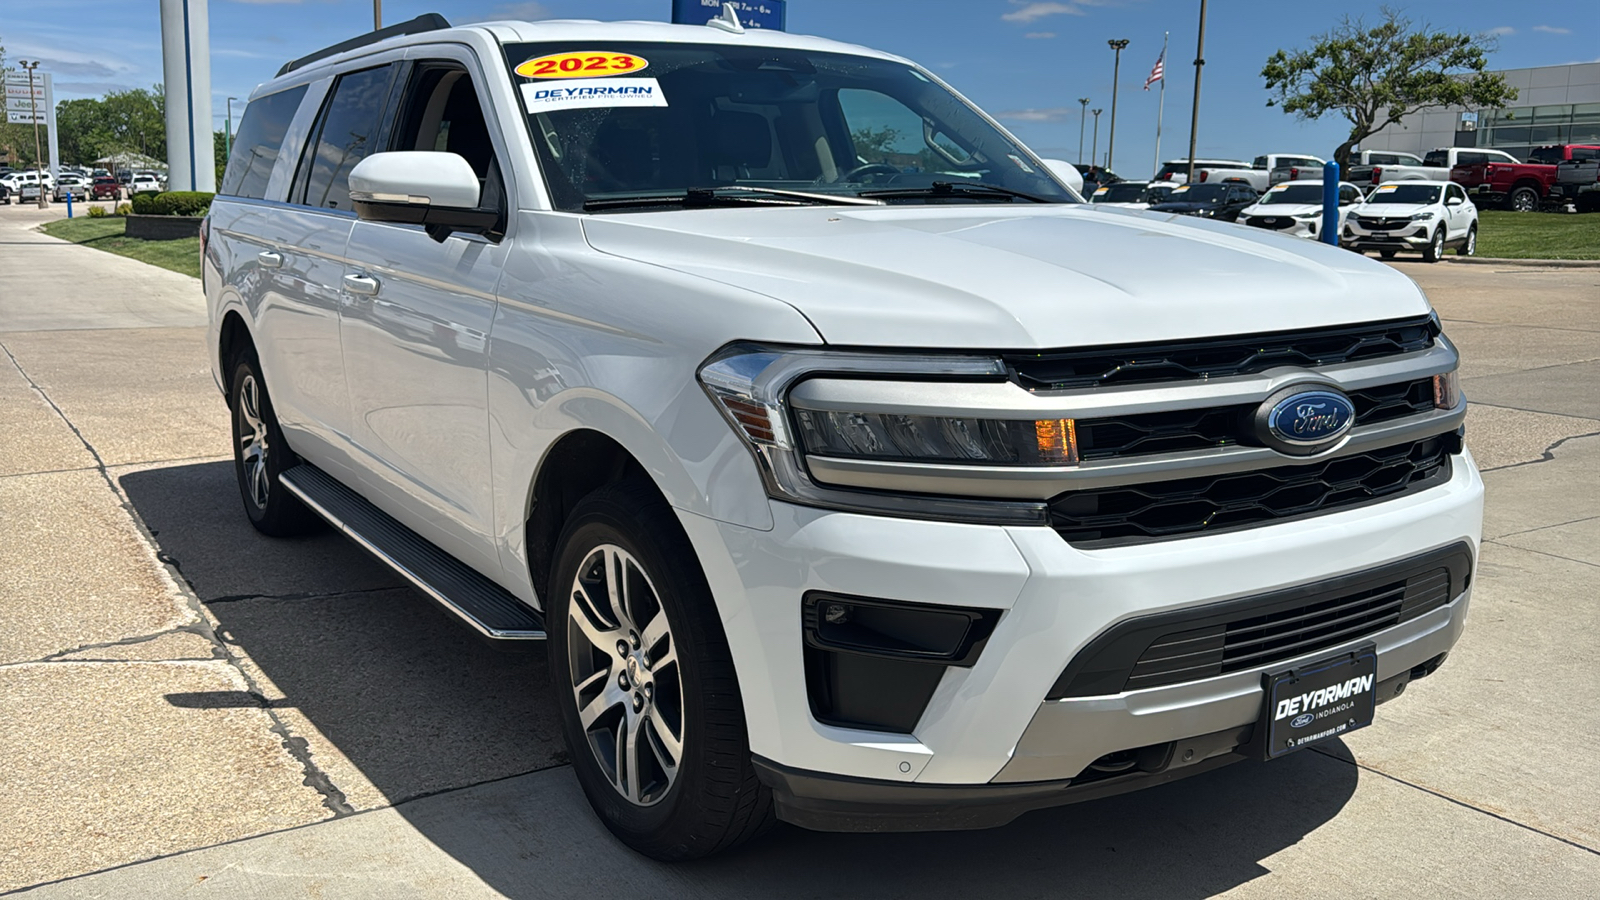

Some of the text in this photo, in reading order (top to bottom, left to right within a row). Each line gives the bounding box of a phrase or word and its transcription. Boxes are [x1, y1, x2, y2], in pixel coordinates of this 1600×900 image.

[532, 56, 635, 75] 2023
[534, 86, 652, 99] DEYARMAN
[545, 94, 594, 102] CERTIFIED
[1293, 402, 1339, 434] Ford
[1274, 673, 1374, 721] DEYARMAN
[1315, 701, 1355, 719] INDIANOLA
[1297, 723, 1347, 745] DEYARMANFORD.COM
